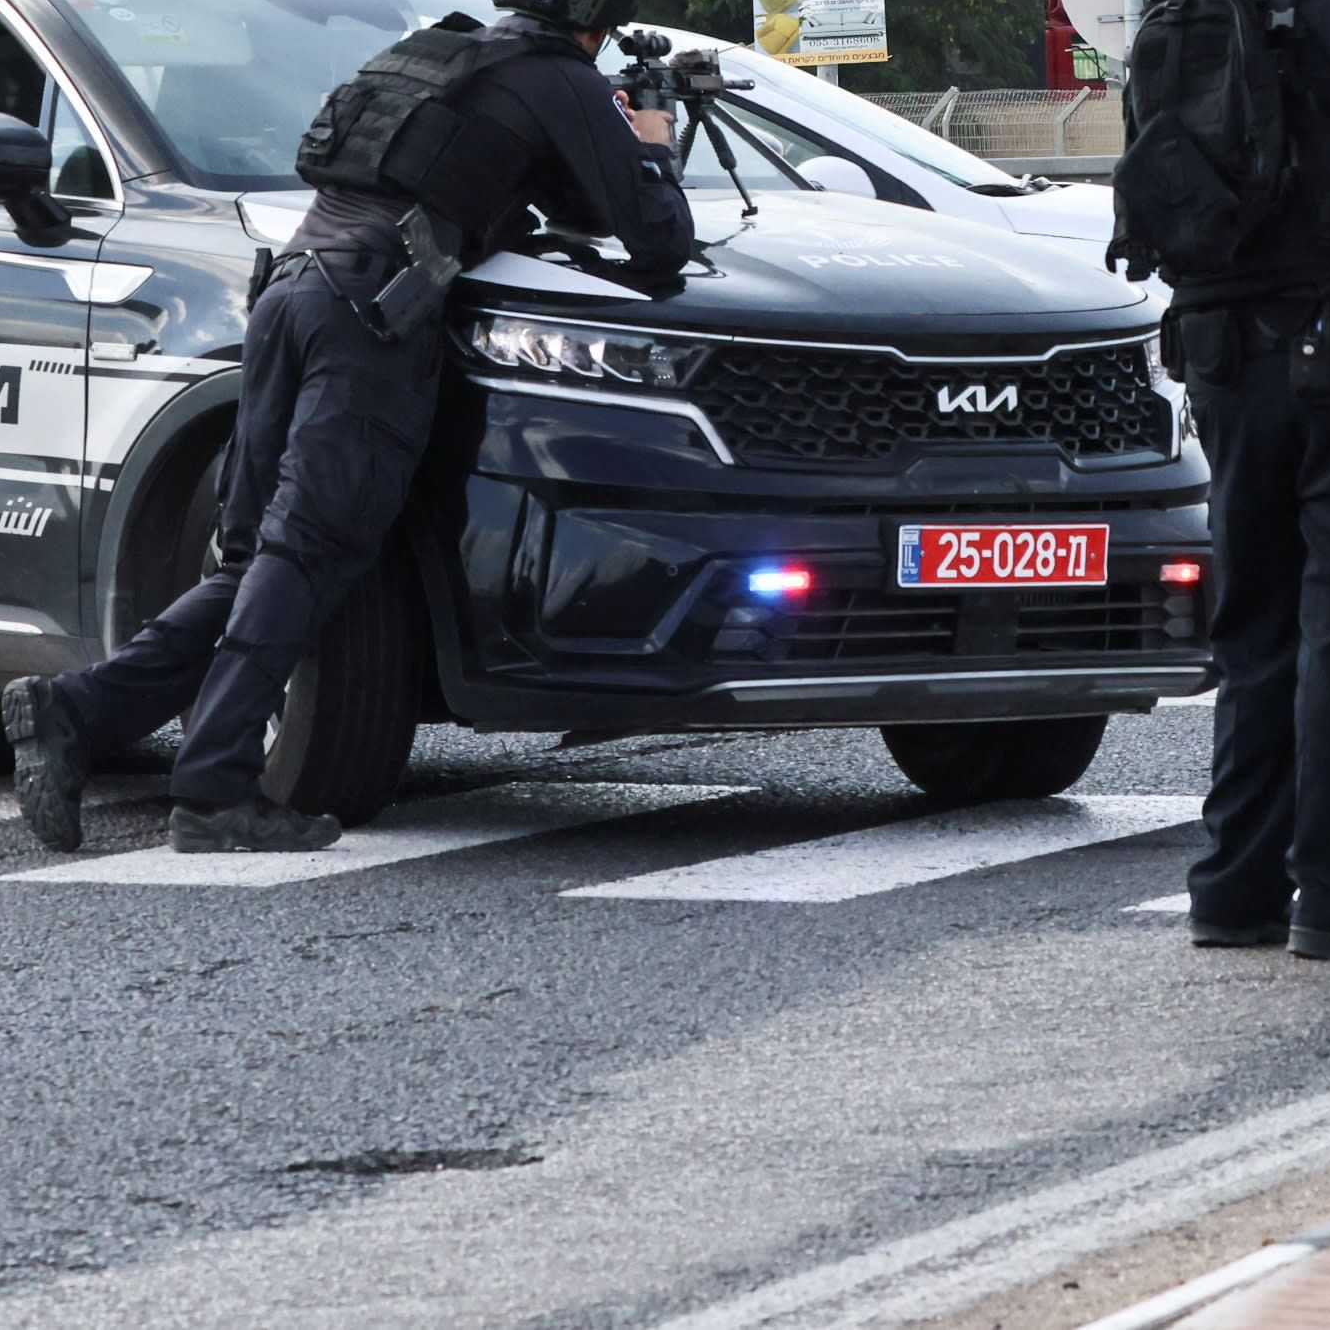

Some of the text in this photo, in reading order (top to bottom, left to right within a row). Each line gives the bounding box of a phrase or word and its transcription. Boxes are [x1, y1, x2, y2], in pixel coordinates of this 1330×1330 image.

[797, 254, 965, 269] POLICE
[937, 385, 1018, 412] KIA
[904, 545, 915, 567] IL
